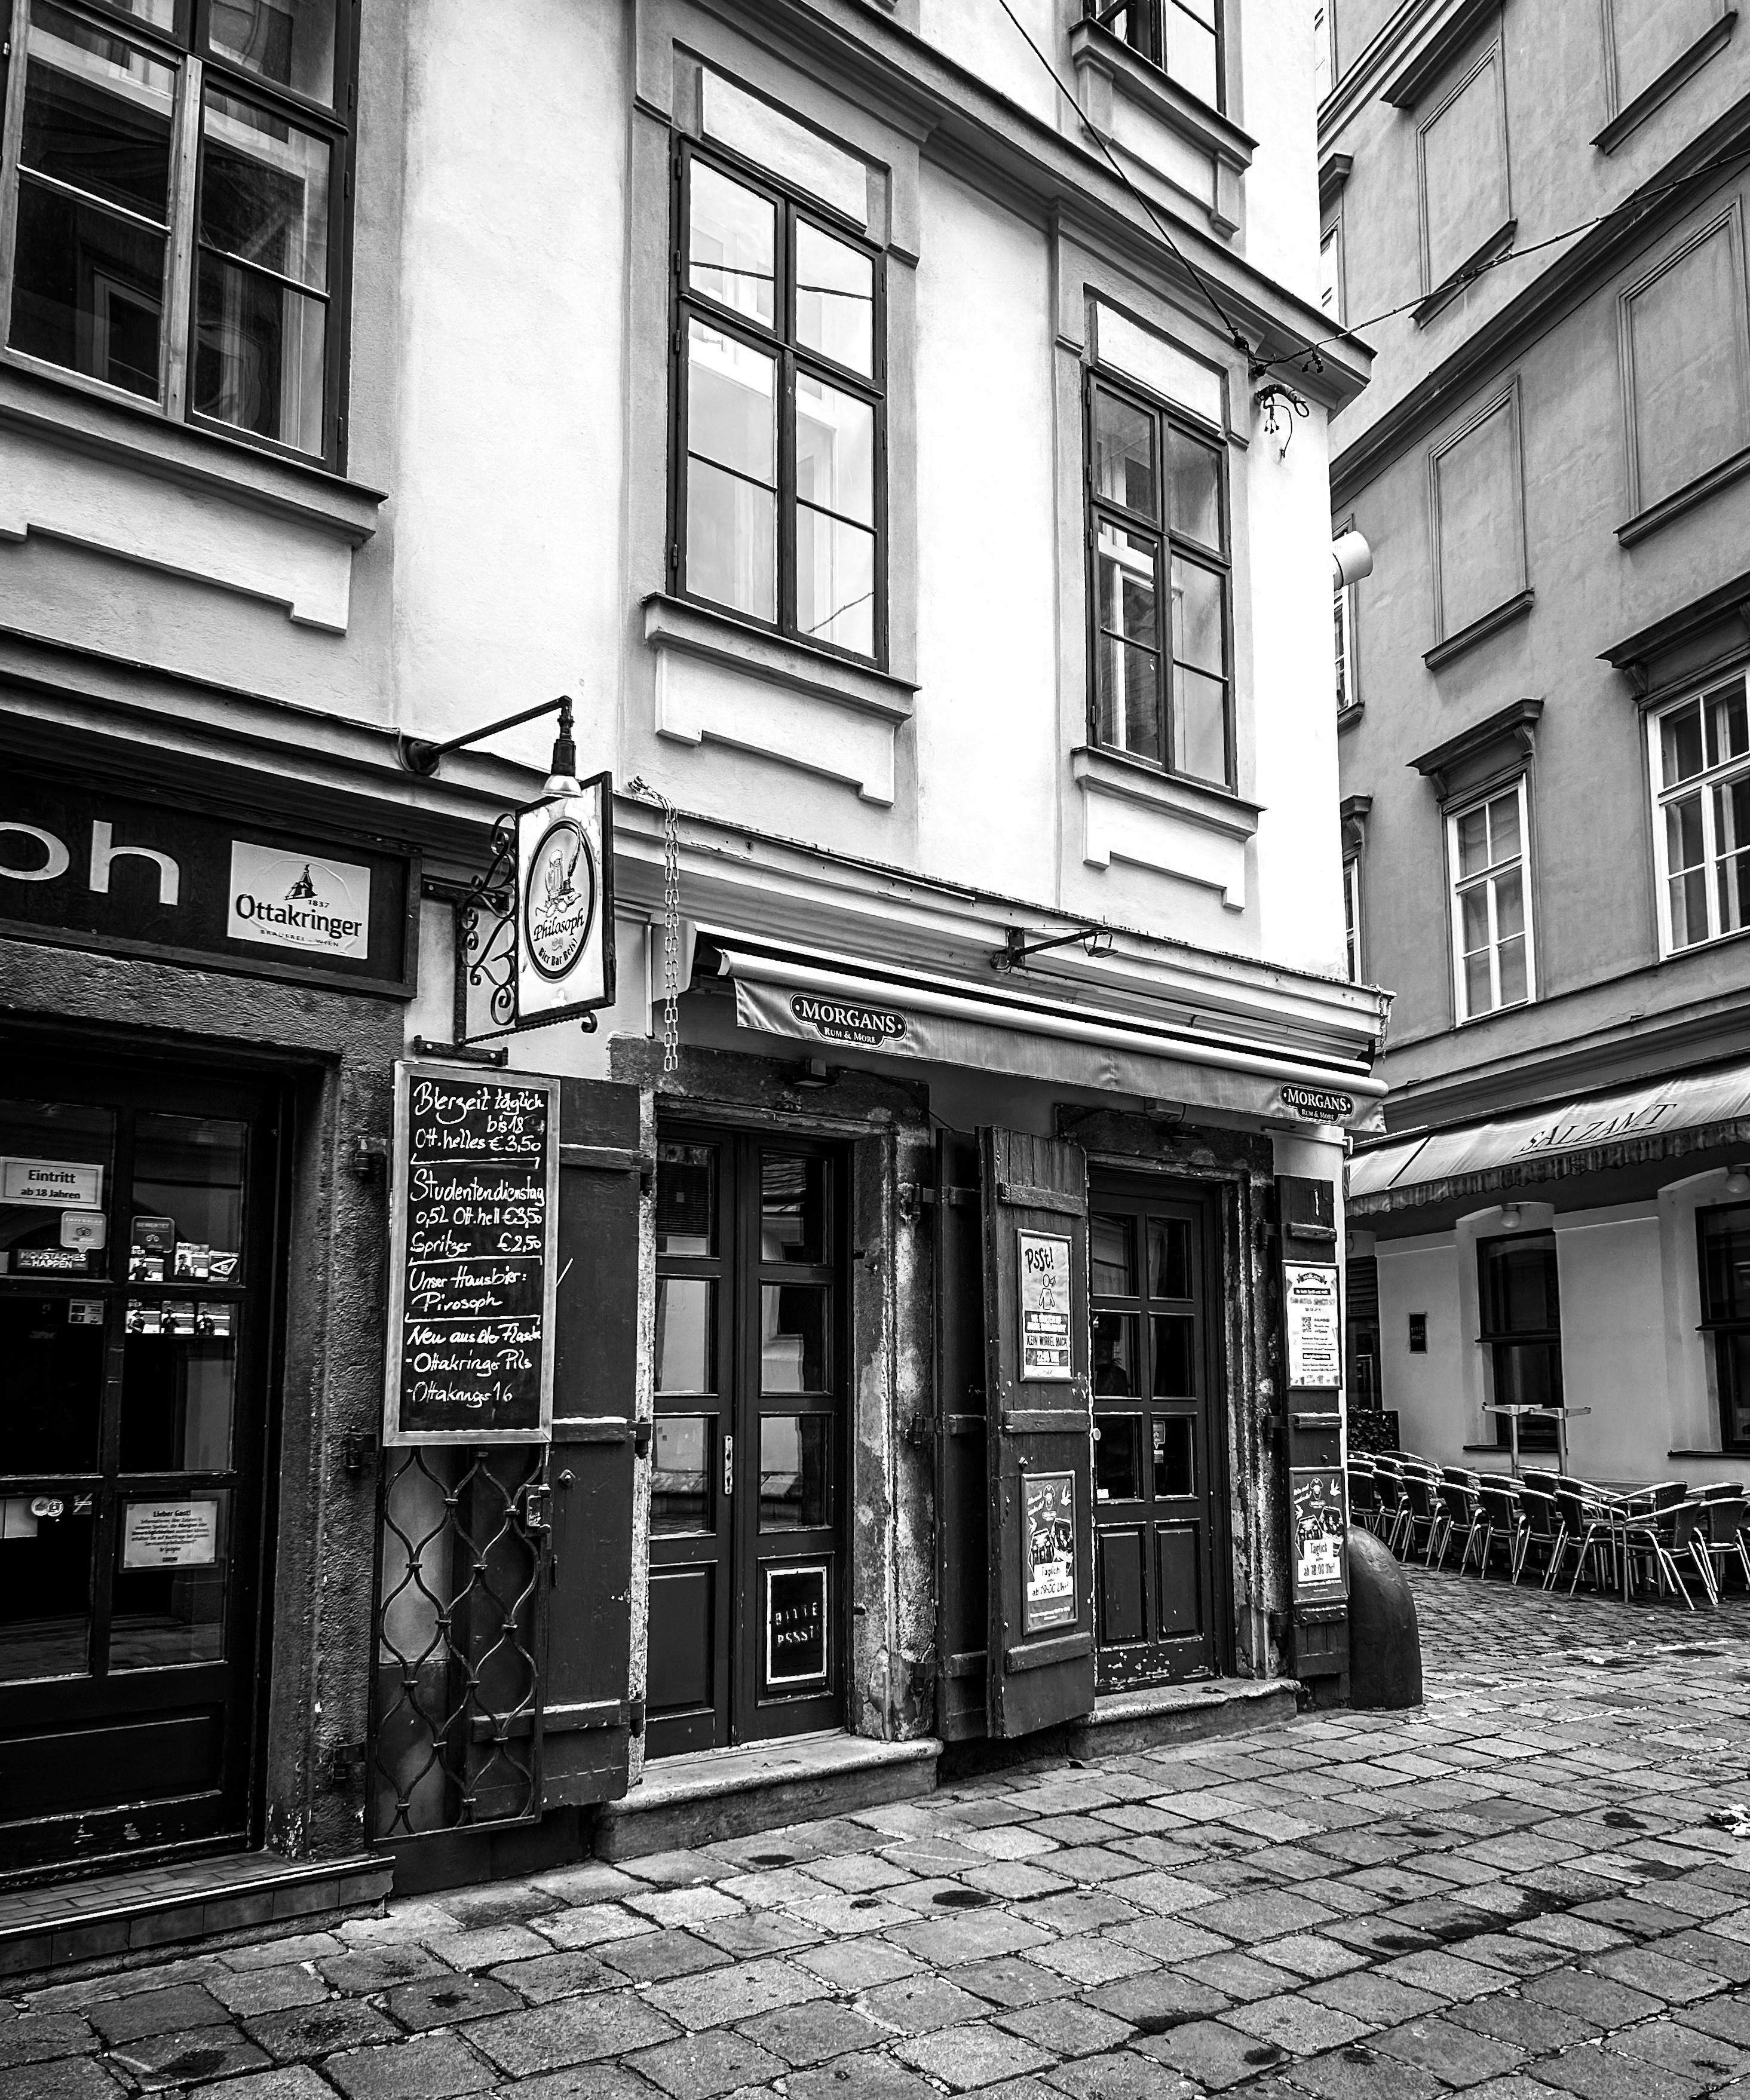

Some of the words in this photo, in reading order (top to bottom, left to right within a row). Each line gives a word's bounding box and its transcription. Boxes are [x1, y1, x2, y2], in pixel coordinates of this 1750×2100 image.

[308, 899, 329, 908] 1837
[236, 894, 363, 939] Ottakringer
[534, 908, 584, 942] Philosoph
[551, 956, 562, 965] Bar
[801, 1000, 896, 1034] MORGANS
[494, 1089, 545, 1115] täglich
[1287, 1089, 1346, 1111] MORGANS
[1520, 1103, 1677, 1152] SALZAMT
[28, 1169, 76, 1184] Eintritt
[21, 1187, 33, 1197] ab
[36, 1188, 47, 1197] 18
[49, 1190, 81, 1200] Jahren
[32, 1259, 73, 1268] HAPPEN
[410, 1268, 448, 1291] Unser
[407, 1325, 447, 1345] Neu
[497, 1349, 533, 1369] Pils
